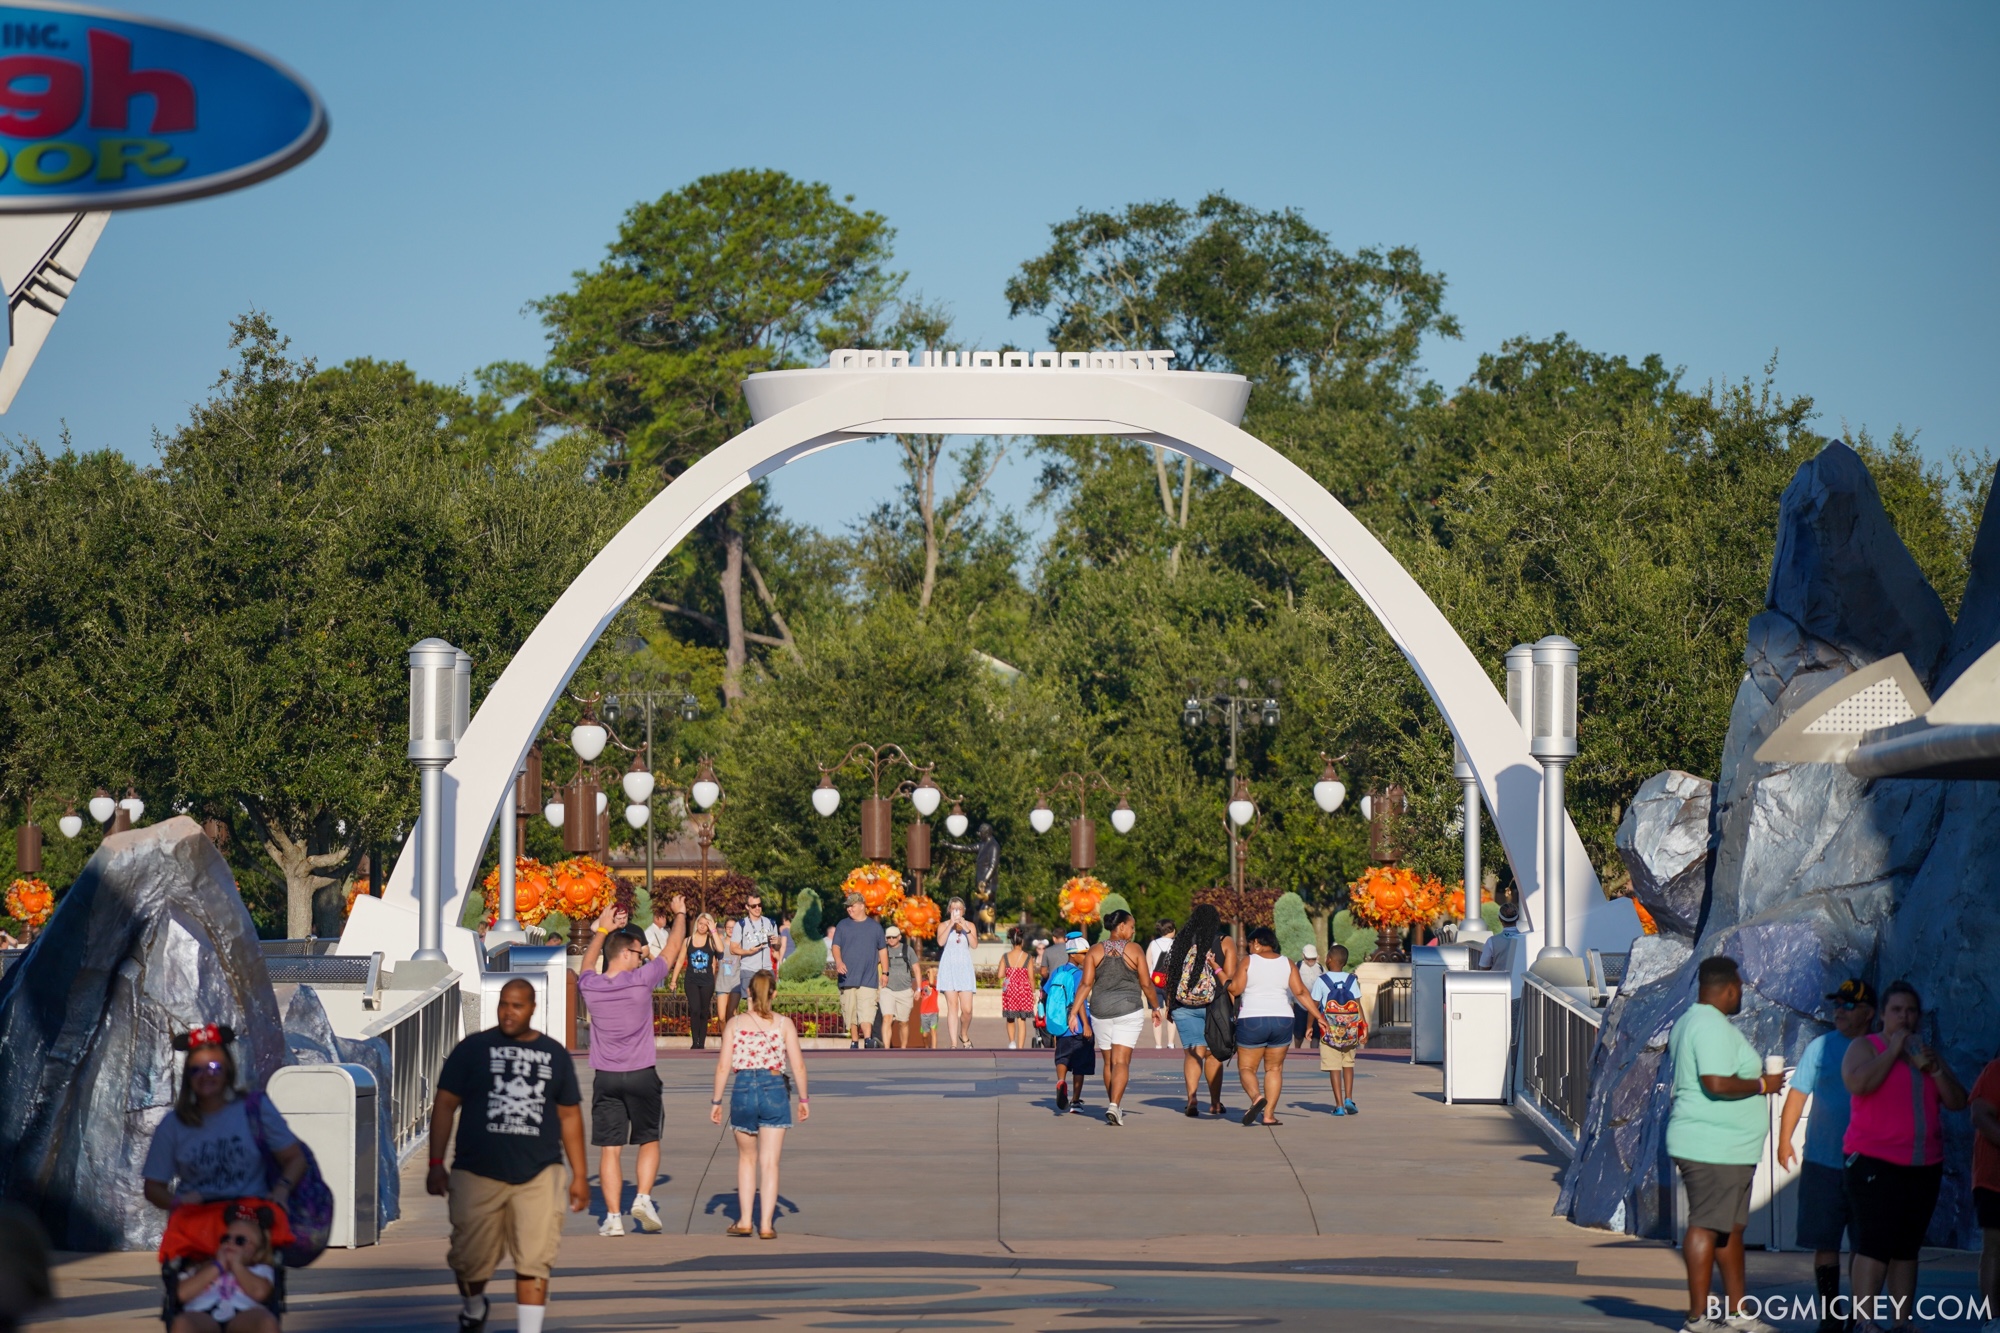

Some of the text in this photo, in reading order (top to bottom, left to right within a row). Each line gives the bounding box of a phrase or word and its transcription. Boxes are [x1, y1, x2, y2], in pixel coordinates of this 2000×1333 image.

[2, 22, 70, 50] INC.
[0, 138, 188, 185] OR
[489, 1046, 552, 1065] KENNY
[486, 1122, 541, 1136] CLEANER
